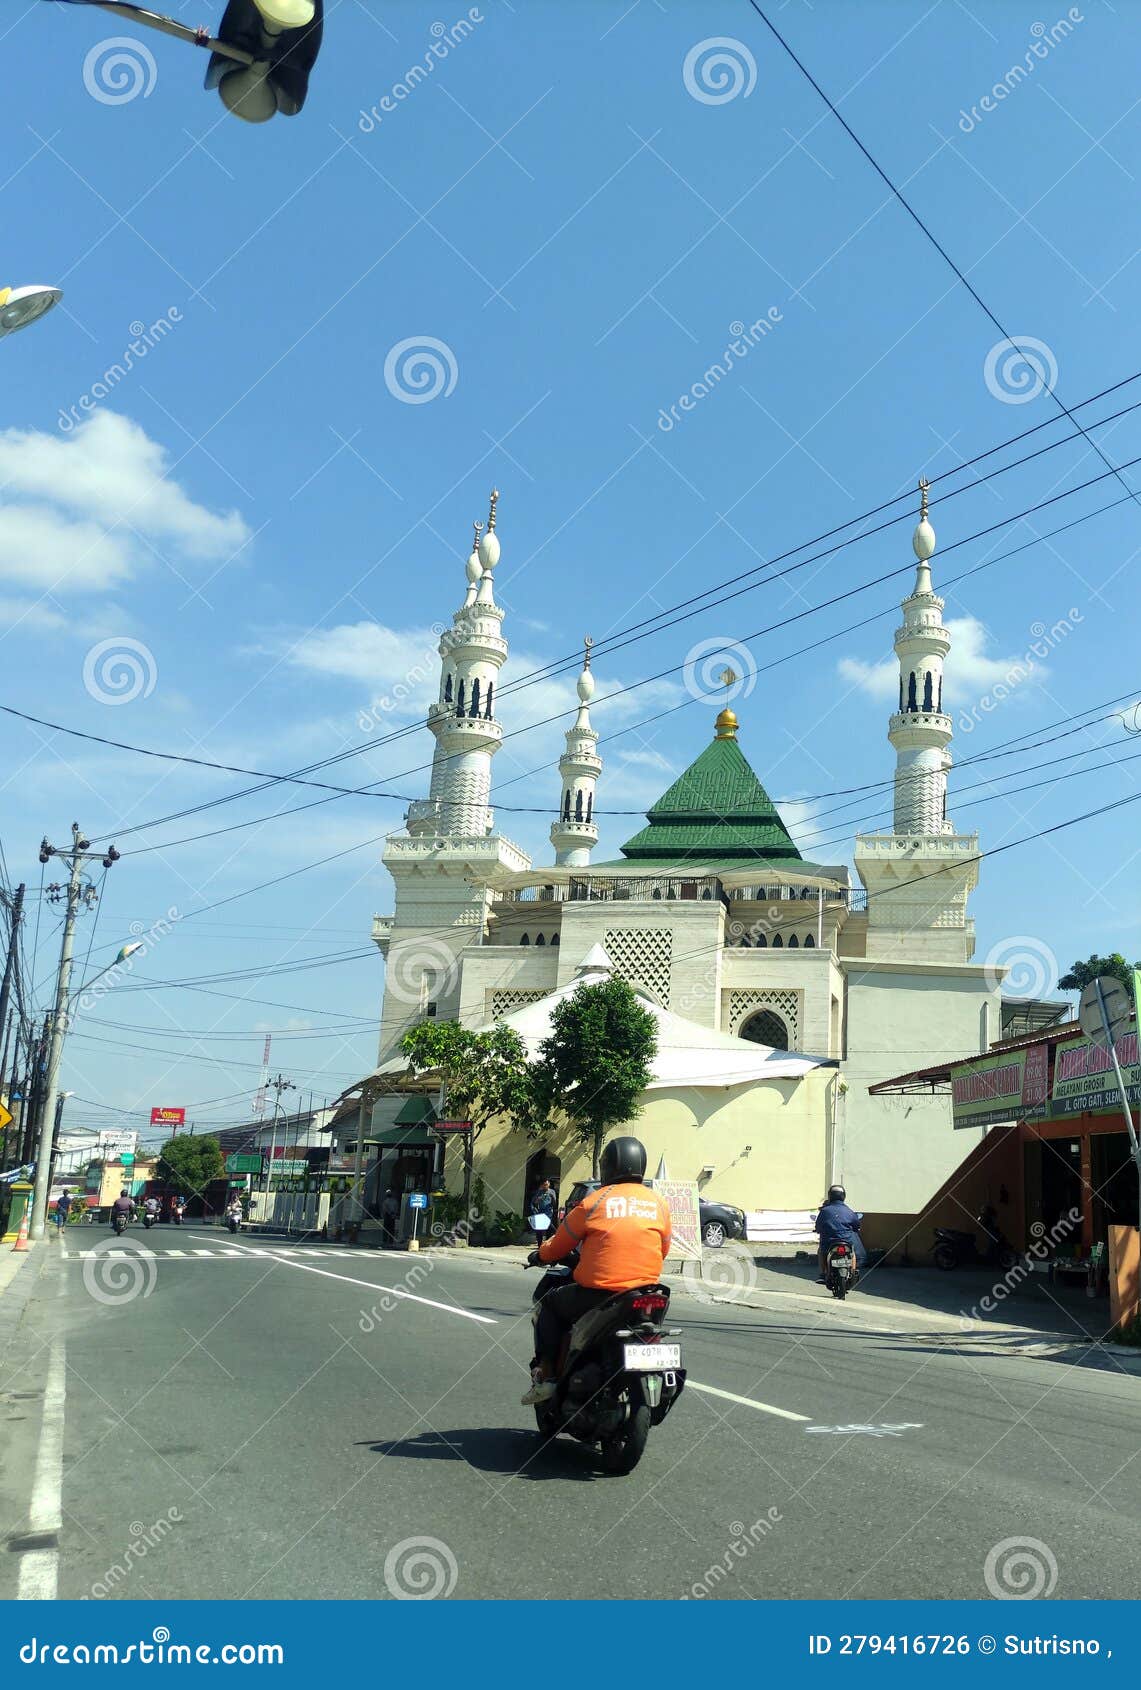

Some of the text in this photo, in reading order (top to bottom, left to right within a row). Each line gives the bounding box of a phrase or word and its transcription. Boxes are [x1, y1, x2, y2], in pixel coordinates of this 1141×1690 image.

[1056, 1079, 1083, 1098] MELAYANI
[1083, 1075, 1106, 1094] GROSIR
[1064, 1101, 1072, 1112] JL.
[1073, 1097, 1087, 1110] GITO
[1105, 1087, 1133, 1105] SLEMN,
[629, 1206, 657, 1220] Food
